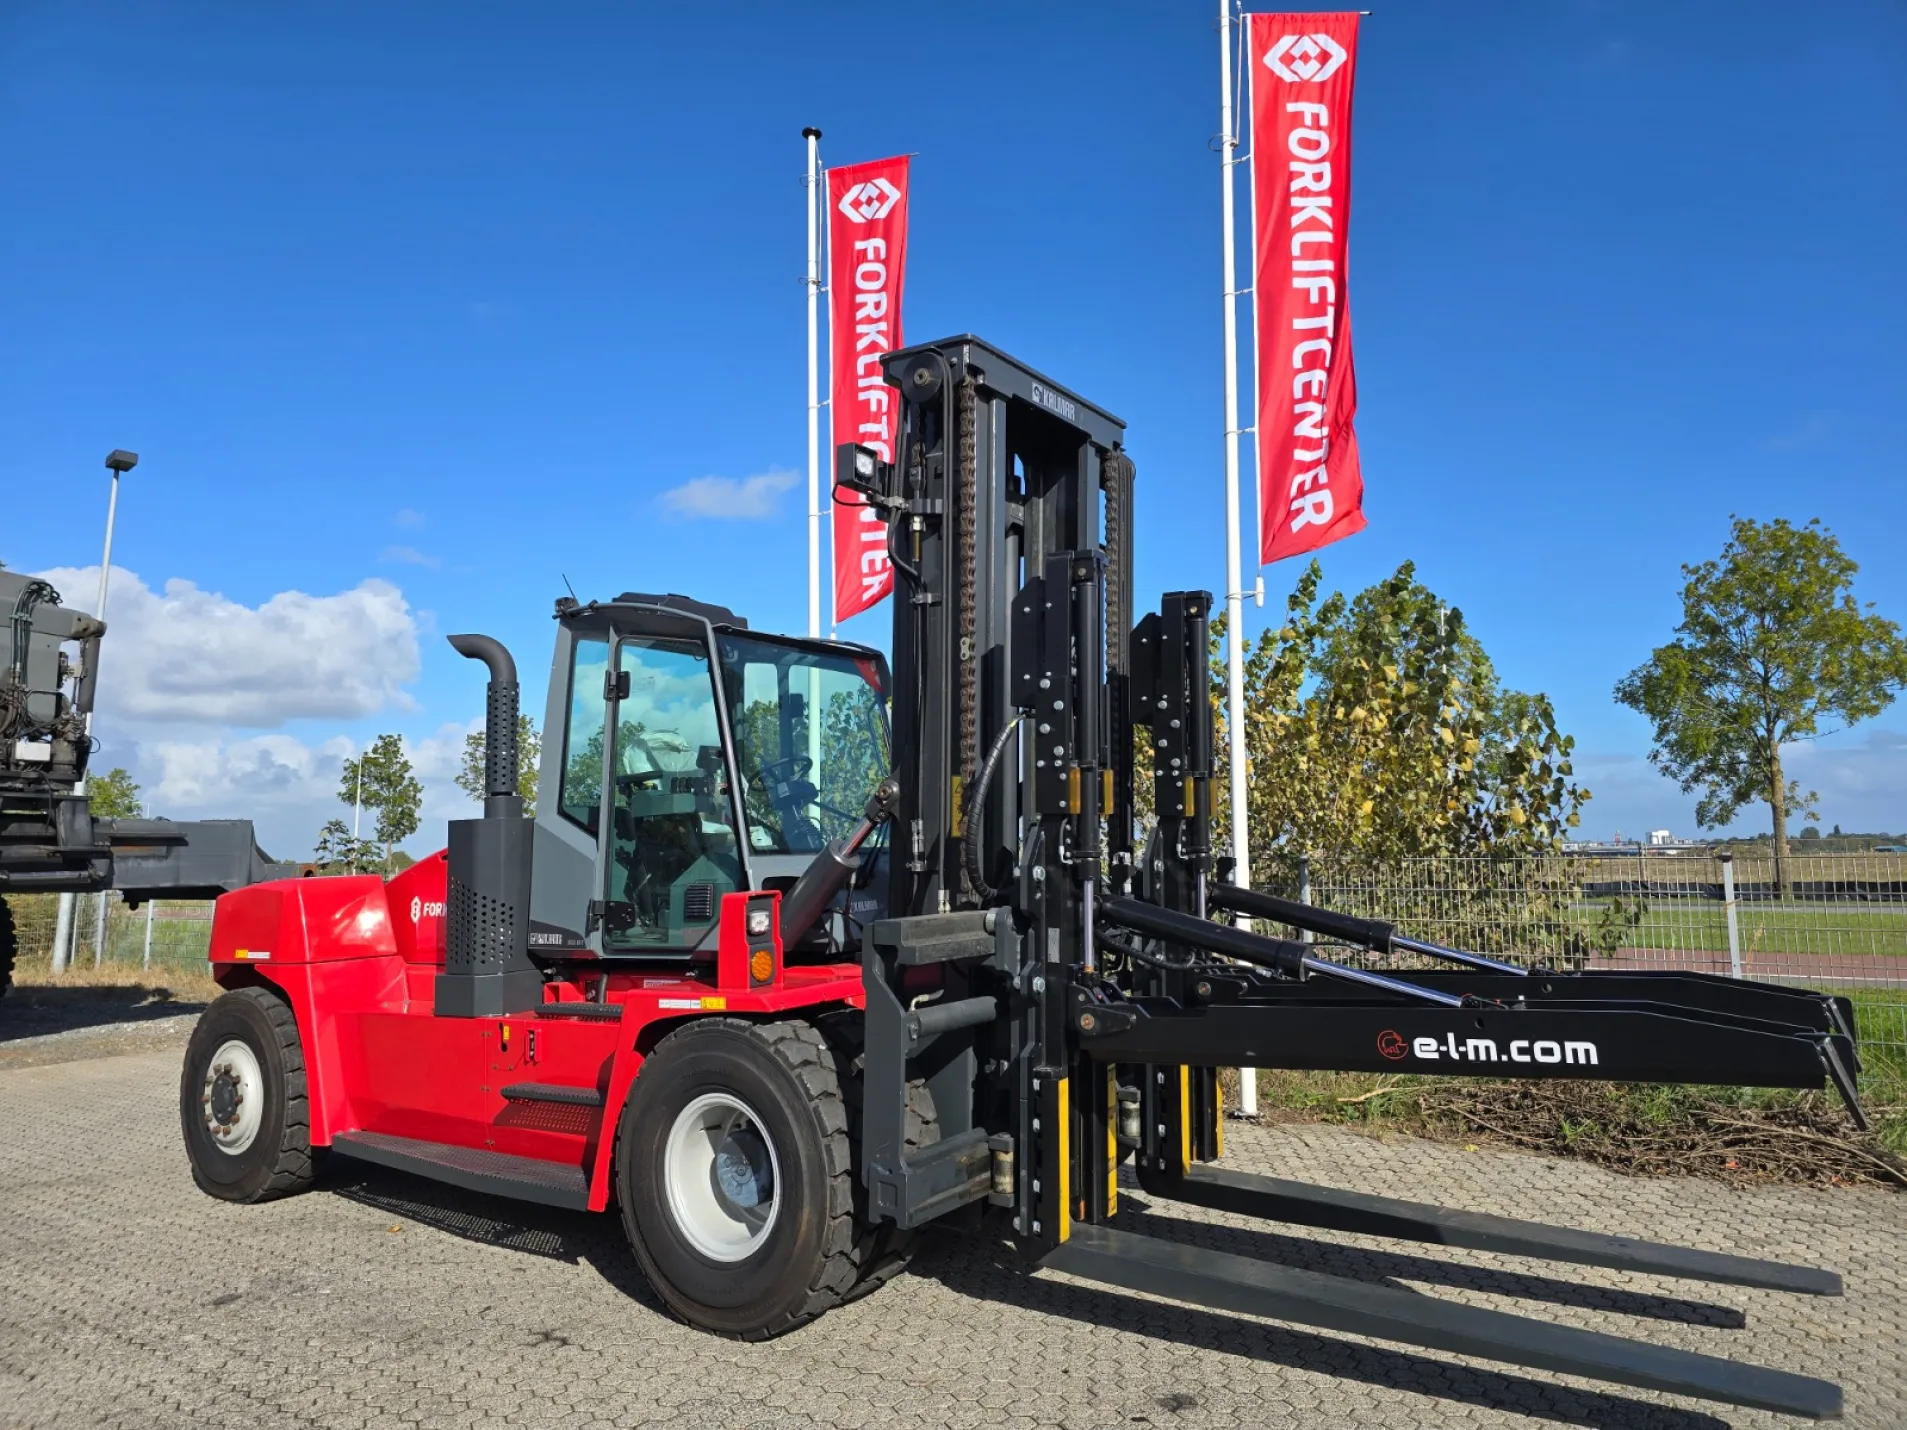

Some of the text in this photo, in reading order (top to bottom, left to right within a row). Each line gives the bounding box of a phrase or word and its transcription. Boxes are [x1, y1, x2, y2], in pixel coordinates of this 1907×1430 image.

[1285, 101, 1336, 534] FORKLIFTCENTER
[1043, 388, 1075, 421] KALMAR
[1412, 1032, 1599, 1065] e-l-m.com
